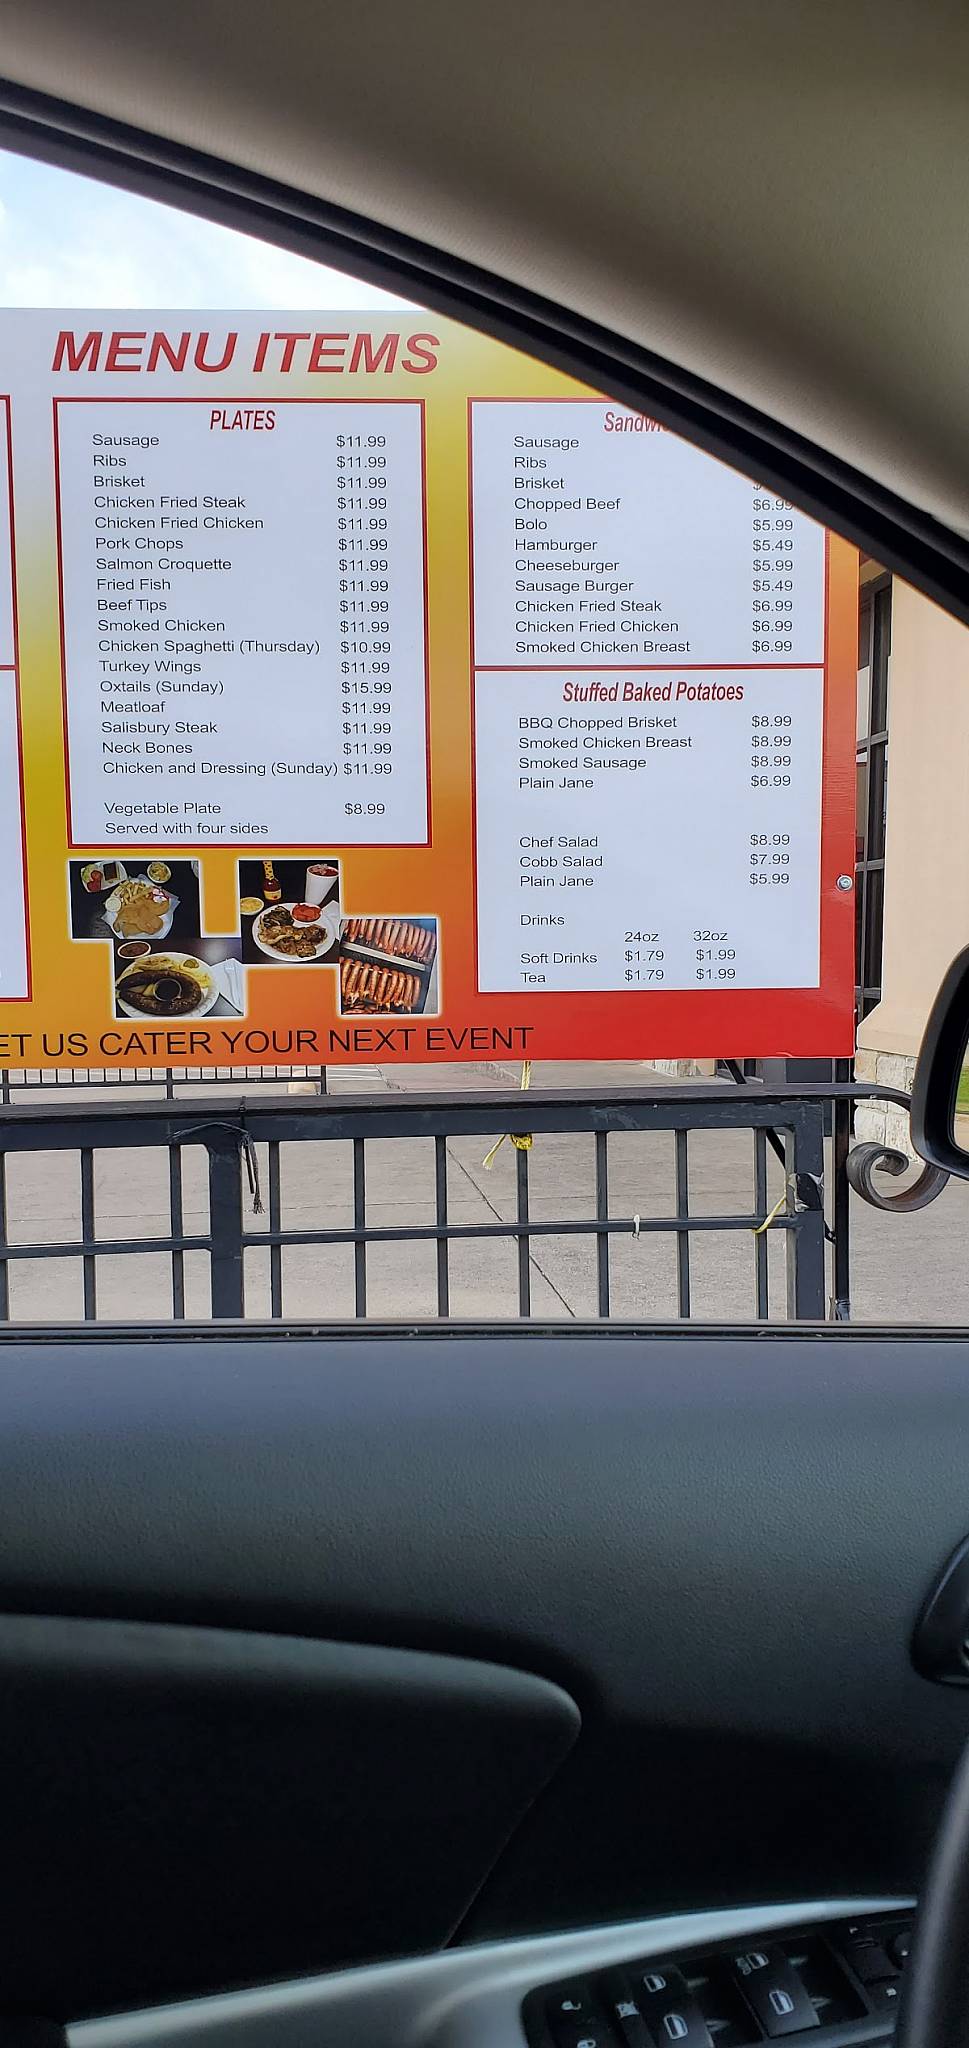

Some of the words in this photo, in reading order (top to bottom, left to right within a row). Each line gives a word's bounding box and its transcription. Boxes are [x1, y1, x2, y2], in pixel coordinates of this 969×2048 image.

[52, 331, 238, 372] MENU
[253, 333, 440, 373] ITEMS
[210, 410, 275, 430] PLATES
[93, 434, 159, 448] Sausage
[337, 435, 385, 448] $11.99
[514, 436, 579, 450] Sausage
[94, 455, 126, 466] Ribs
[337, 456, 386, 469] $11.99
[515, 457, 546, 468] Ribs
[94, 476, 145, 487] Brisket
[338, 477, 386, 489] $11.99
[515, 477, 564, 489] Brisket
[95, 496, 154, 508] Chicken
[161, 496, 197, 508] Fried
[203, 496, 245, 508] Steak
[338, 497, 386, 509] $11.99
[515, 498, 581, 512] Chopped
[587, 498, 620, 509] Beef
[95, 517, 155, 528] Chicken
[161, 517, 197, 528] Fried
[204, 517, 263, 528] Chicken
[338, 518, 387, 530] $11.99
[515, 518, 547, 530] Bolo
[753, 519, 793, 531] $5.99
[96, 538, 130, 549] Pork
[135, 538, 183, 552] Chops
[339, 538, 387, 551] $11.99
[516, 539, 597, 553] Hamburger
[753, 539, 793, 552] $5.49
[96, 558, 152, 570] Salmon
[159, 558, 231, 572] Croquette
[339, 559, 388, 572] $11.99
[516, 560, 619, 573] Cheeseburger
[753, 559, 793, 571] $5.99
[97, 579, 134, 590] Fried
[140, 579, 170, 590] Fish
[340, 579, 388, 593] $11.99
[516, 580, 579, 594] Sausage
[585, 580, 634, 594] Burger
[753, 580, 792, 592] $5.49
[98, 599, 132, 611] Beef
[136, 599, 167, 613] Tips
[340, 600, 388, 613] $11.99
[516, 601, 573, 612] Chicken
[580, 601, 615, 612] Fried
[621, 600, 662, 611] Steak
[752, 600, 792, 613] $6.99
[98, 620, 159, 631] Smoked
[165, 620, 224, 631] Chicken
[340, 621, 389, 634] $11.99
[516, 621, 573, 632] Chicken
[580, 621, 615, 632] Fried
[621, 620, 678, 632] Chicken
[753, 620, 792, 633] $6.99
[99, 640, 158, 651] Chicken
[164, 640, 234, 654] Spaghetti
[240, 640, 319, 655] (Thursday)
[341, 641, 390, 654] $10.99
[516, 641, 575, 653] Smoked
[581, 641, 638, 652] Chicken
[644, 641, 690, 652] Breast
[752, 640, 792, 654] $6.99
[99, 660, 150, 675] Turkey
[155, 660, 201, 674] Wings
[341, 662, 389, 674] $11.99
[100, 681, 151, 692] Oxtails
[156, 681, 223, 695] (Sunday)
[342, 682, 391, 694] $15.99
[563, 682, 619, 702] Stuffed
[622, 682, 672, 701] Baked
[676, 682, 743, 700] Potatoes
[101, 701, 165, 712] Meatloaf
[342, 702, 390, 715] $11.99
[520, 718, 552, 729] BBQ
[558, 717, 622, 731] Chopped
[629, 717, 677, 728] Brisket
[752, 716, 791, 728] $8.99
[102, 722, 170, 735] Salisbury
[175, 722, 217, 733] Steak
[343, 722, 391, 735] $11.99
[103, 742, 141, 753] Neck
[146, 742, 192, 753] Bones
[519, 737, 577, 748] Smoked
[583, 737, 640, 748] Chicken
[646, 737, 692, 747] Breast
[752, 736, 791, 748] $8.99
[343, 743, 391, 755] $11.99
[520, 757, 577, 768] Smoked
[583, 757, 646, 770] Sausage
[751, 756, 791, 768] $8.99
[104, 762, 163, 773] Chicken
[169, 763, 195, 773] and
[201, 762, 265, 776] Dressing
[272, 762, 337, 776] (Sunday)
[344, 763, 392, 775] $11.99
[520, 777, 553, 788] Plain
[559, 777, 593, 788] Jane
[751, 775, 790, 788] $6.99
[104, 803, 178, 816] Vegetable
[184, 803, 221, 813] Plate
[345, 803, 385, 814] $8.99
[106, 823, 157, 834] Served
[163, 823, 192, 833] with
[197, 823, 226, 833] four
[230, 823, 268, 833] sides
[520, 837, 554, 847] Chef
[558, 836, 597, 847] Salad
[750, 834, 789, 845] $8.99
[520, 856, 557, 867] Cobb
[563, 856, 602, 867] Salad
[750, 854, 789, 865] $7.99
[521, 876, 554, 886] Plain
[560, 876, 593, 886] Jane
[750, 873, 789, 885] $5.99
[521, 915, 564, 925] Drinks
[625, 932, 659, 942] 24oz
[694, 931, 728, 941] 32oz
[521, 953, 548, 963] Soft
[554, 953, 597, 963] Drinks
[625, 950, 664, 962] $1.79
[696, 949, 735, 961] $1.99
[520, 972, 545, 983] Tea
[625, 969, 664, 982] $1.79
[696, 969, 735, 979] $1.99
[43, 1033, 88, 1056] US
[100, 1032, 213, 1055] CATER
[221, 1030, 319, 1053] YOUR
[330, 1029, 416, 1052] NEXT
[427, 1027, 534, 1050] EVENT
